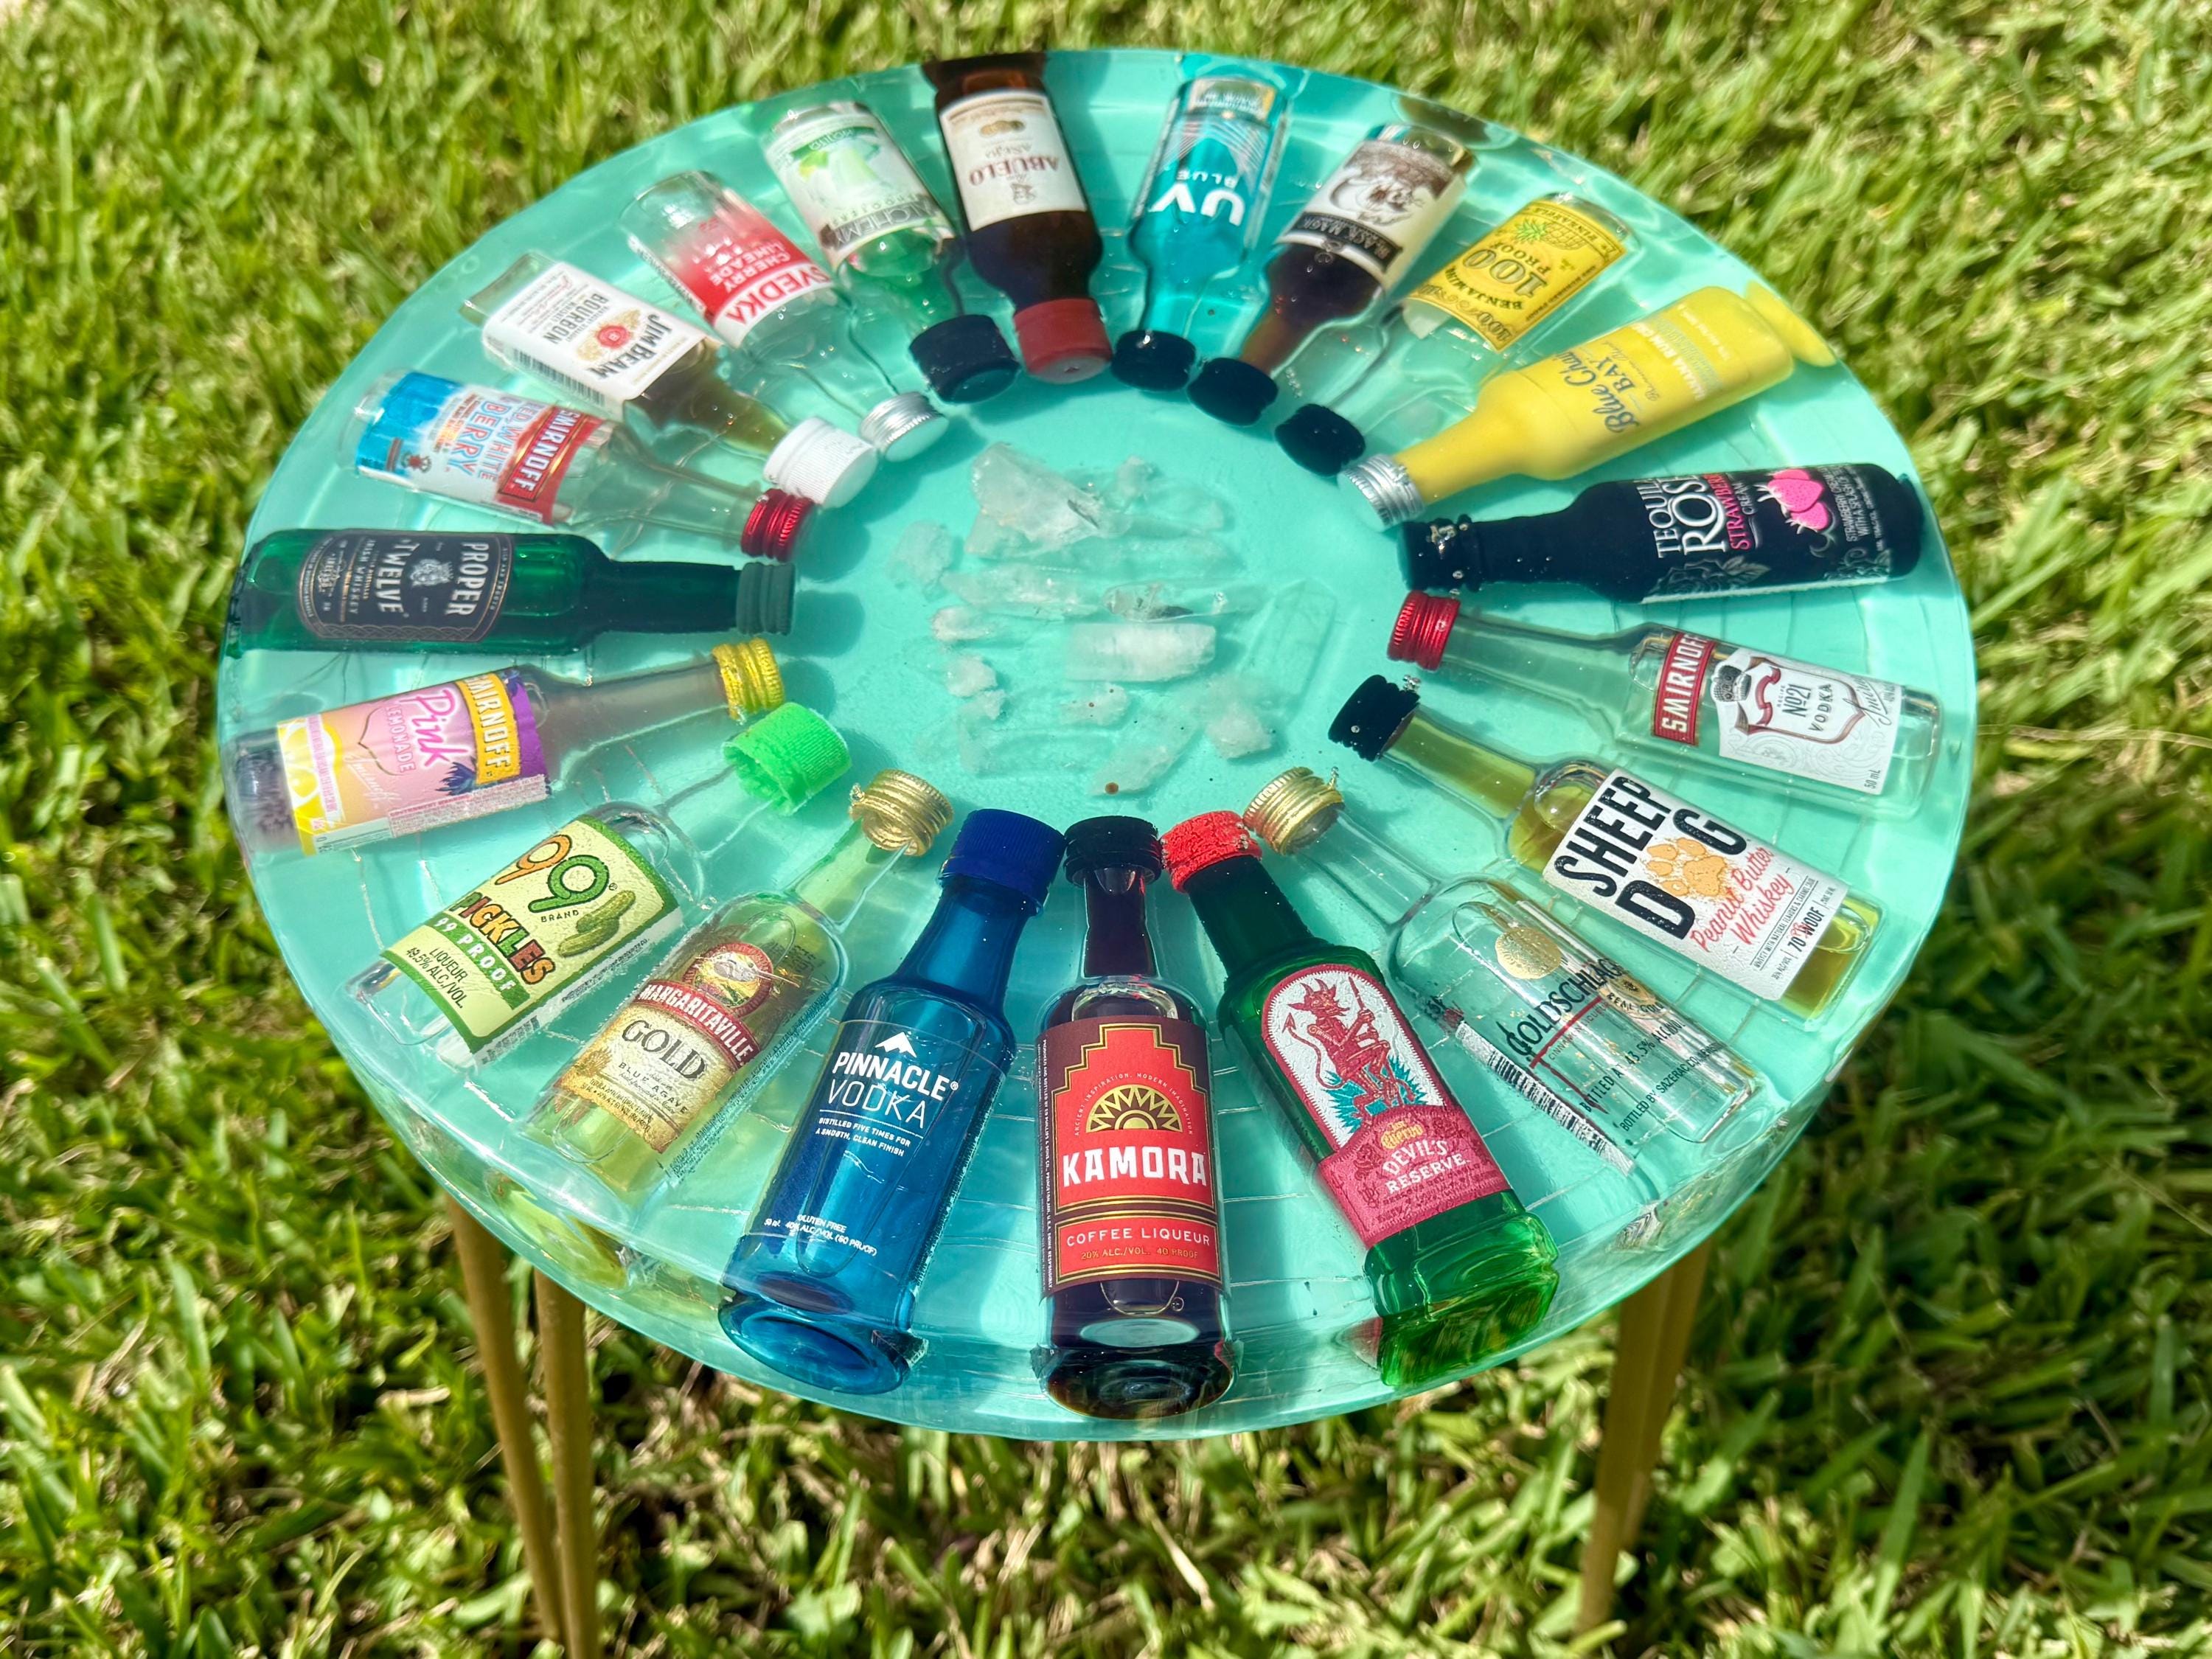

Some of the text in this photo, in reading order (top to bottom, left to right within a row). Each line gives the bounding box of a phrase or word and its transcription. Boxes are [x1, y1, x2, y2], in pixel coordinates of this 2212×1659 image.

[967, 155, 1059, 186] ABUELO
[1177, 168, 1237, 189] BLUE
[1146, 180, 1246, 226] UV
[708, 240, 785, 287] LIMEADE
[722, 249, 791, 293] CHERRY
[1463, 248, 1548, 300] 100
[1489, 241, 1550, 276] PROOF
[724, 265, 830, 324] SVEDKA
[542, 293, 609, 345] BOURBON
[639, 316, 672, 347] JIM
[586, 343, 657, 380] BEAM
[1589, 356, 1636, 393] BAY
[1590, 383, 1640, 433] Blue
[446, 400, 511, 476] BERRY
[477, 425, 523, 482] WHITE
[513, 408, 581, 492] SMIRNOFF
[1834, 493, 1857, 541] STRAWBERRY
[1854, 516, 1870, 536] WITH
[359, 540, 375, 562] IRISH
[349, 566, 366, 613] WHISKEY
[375, 543, 420, 613] TWELVE
[444, 541, 489, 616] PROPER
[1660, 633, 1708, 733] SMIRNOFF
[1775, 684, 1786, 708] RECIPE
[397, 689, 468, 768] Pink
[464, 674, 510, 767] SMIRNOFF
[1808, 684, 1833, 731] VODKA
[384, 703, 416, 773] LEMONADE
[1863, 779, 1877, 789] 50
[1552, 771, 1674, 900] SHEEP
[495, 832, 606, 914] 99
[541, 910, 578, 922] BRAND
[1688, 844, 1775, 953] Peanut Butter
[1729, 872, 1795, 945] Whiskey
[448, 891, 554, 984] PICKLES
[1771, 922, 1787, 941] NATURAL
[1783, 905, 1798, 923] FLAVORS
[1787, 935, 1807, 953] 70
[1797, 905, 1825, 936] WOOF
[405, 947, 467, 1009] 49.5% ALC./VOL.
[428, 946, 468, 983] LIQUEUR
[434, 916, 458, 931] 99
[456, 933, 517, 993] PROOF
[621, 1018, 706, 1082] GOLD
[1547, 1025, 1585, 1061] CINNAMON
[619, 1061, 649, 1083] BLUE
[651, 1084, 688, 1115] AGAVE
[831, 1051, 950, 1102] PINNACLE
[1578, 1074, 1616, 1113] BOTTLED
[1622, 1038, 1656, 1067] 43.5%
[1619, 1062, 1691, 1132] BOTTLED BY SAZERAC
[828, 1079, 925, 1129] VODKA
[1074, 1104, 1085, 1136] ANCIENT
[1085, 1073, 1132, 1102] INSPIRATION.
[1136, 1072, 1167, 1087] MODERN
[818, 1117, 911, 1147] DISTILLED FIVE TIMES FOR
[821, 1128, 850, 1140] SMOOTH,
[852, 1135, 878, 1147] CLEAN
[877, 1141, 905, 1157] FINISH
[1381, 1121, 1425, 1150] Cuervo
[1062, 1145, 1206, 1187] KAMORA
[1385, 1151, 1467, 1194] RESERVE
[785, 1221, 801, 1231] 40%
[848, 1238, 877, 1257] PROOF)
[796, 1214, 846, 1234] GLUTEN FREE
[1066, 1226, 1209, 1247] COFFEE LIQUEUR
[1080, 1246, 1197, 1260] 20% ALC./VOL. 40 PROOF
